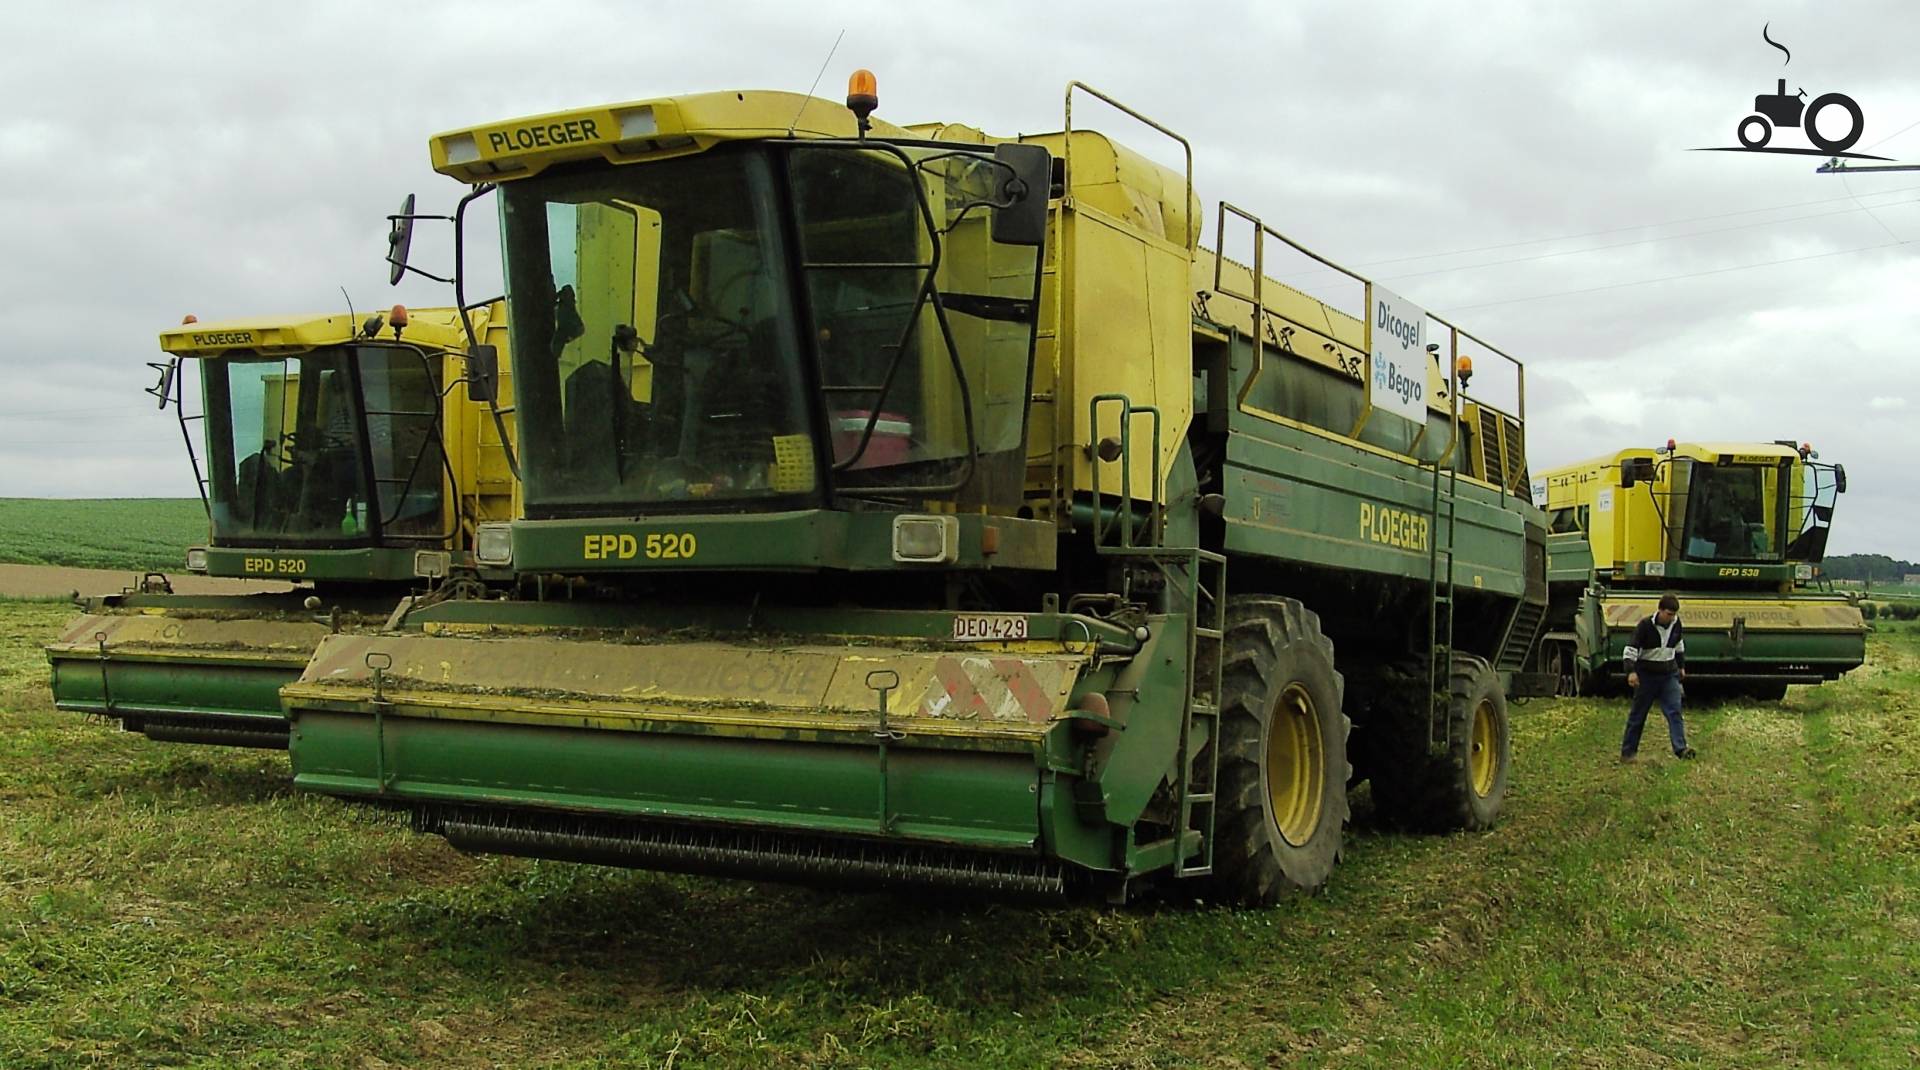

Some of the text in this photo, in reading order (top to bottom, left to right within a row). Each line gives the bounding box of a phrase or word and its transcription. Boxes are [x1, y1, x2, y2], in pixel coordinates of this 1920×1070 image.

[488, 119, 600, 153] PLOEGER
[193, 332, 254, 345] PLOEGER
[1378, 301, 1420, 350] Dicogel
[1388, 362, 1422, 405] Begro
[1360, 502, 1428, 552] PLOEGER
[584, 533, 696, 559] EPD 520
[245, 558, 306, 573] EPD 520
[1719, 567, 1740, 576] EPD
